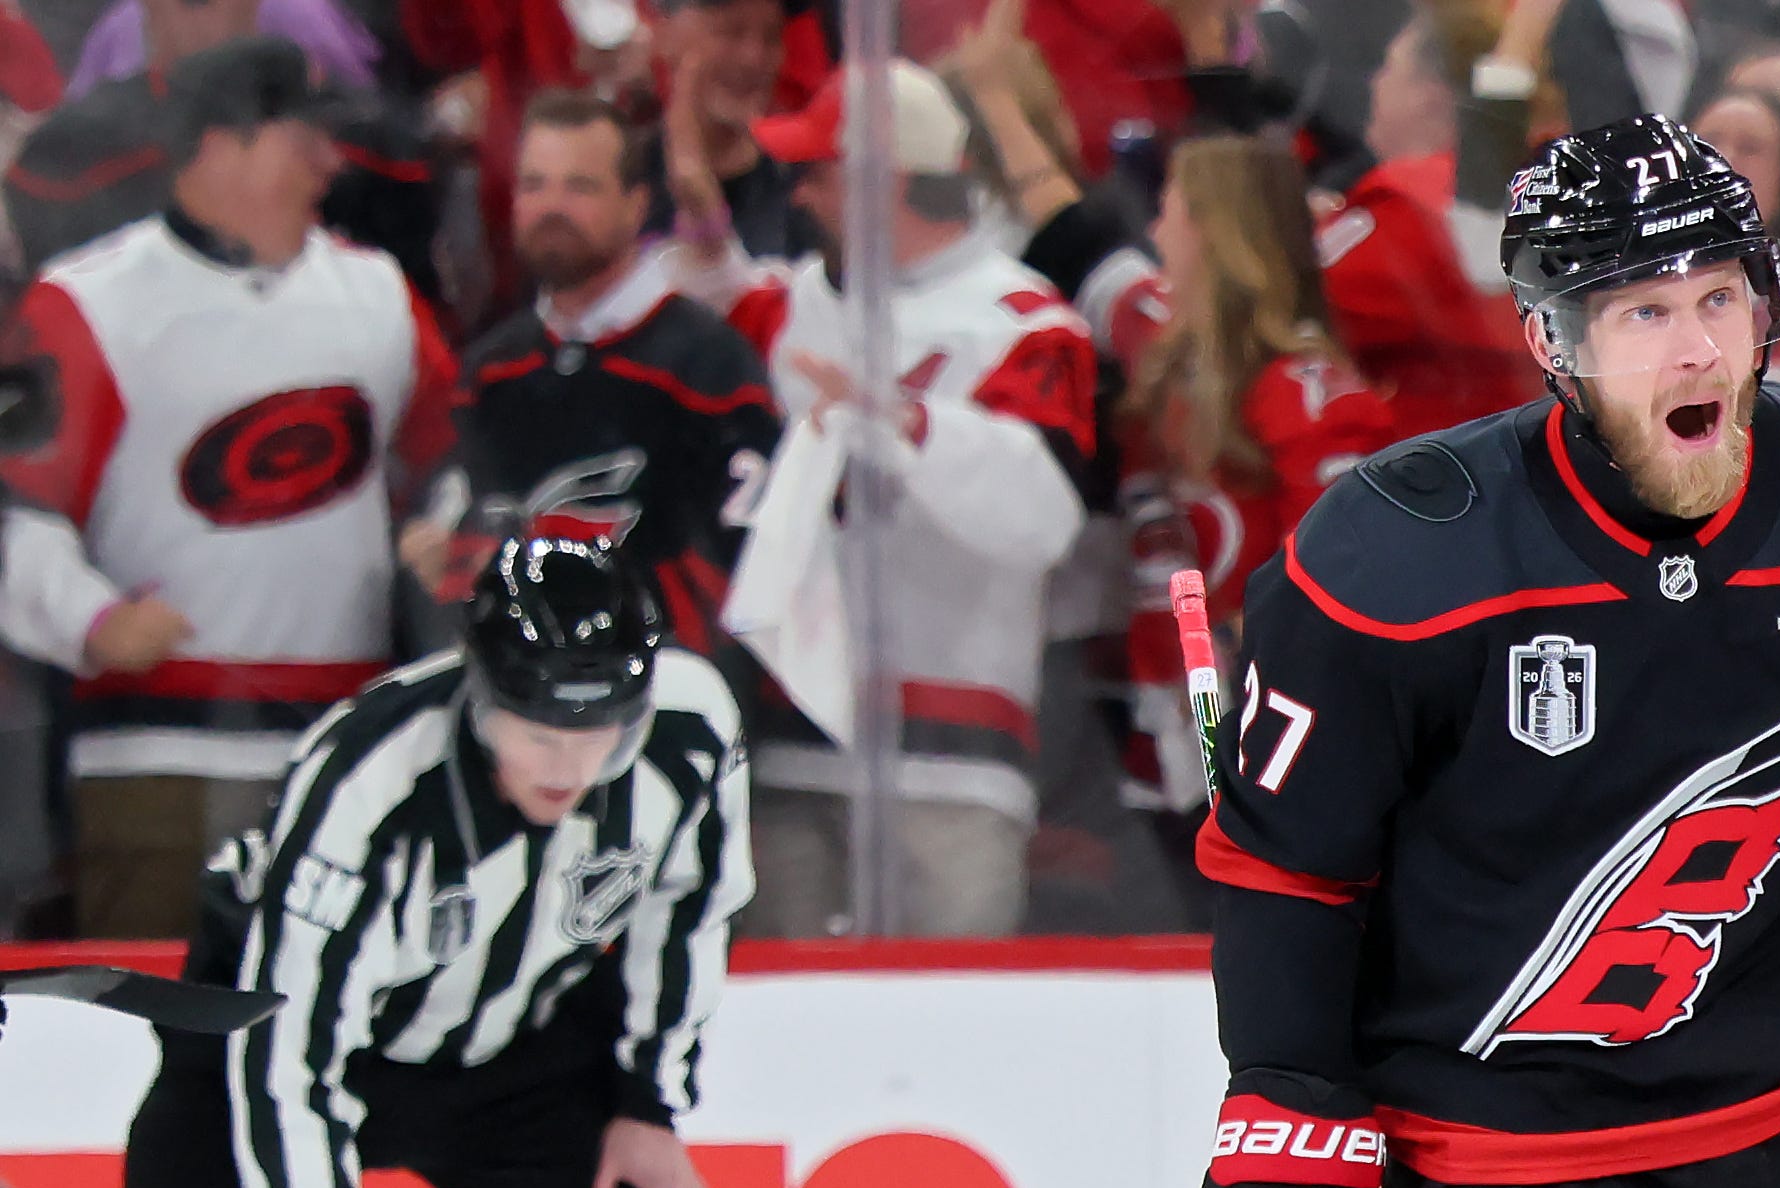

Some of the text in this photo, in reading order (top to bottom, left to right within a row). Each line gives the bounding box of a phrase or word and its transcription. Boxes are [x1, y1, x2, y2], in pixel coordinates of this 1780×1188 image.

[1626, 150, 1680, 187] 27
[1641, 207, 1715, 237] BAUER
[1196, 671, 1214, 687] 27
[1522, 671, 1582, 683] 20 26
